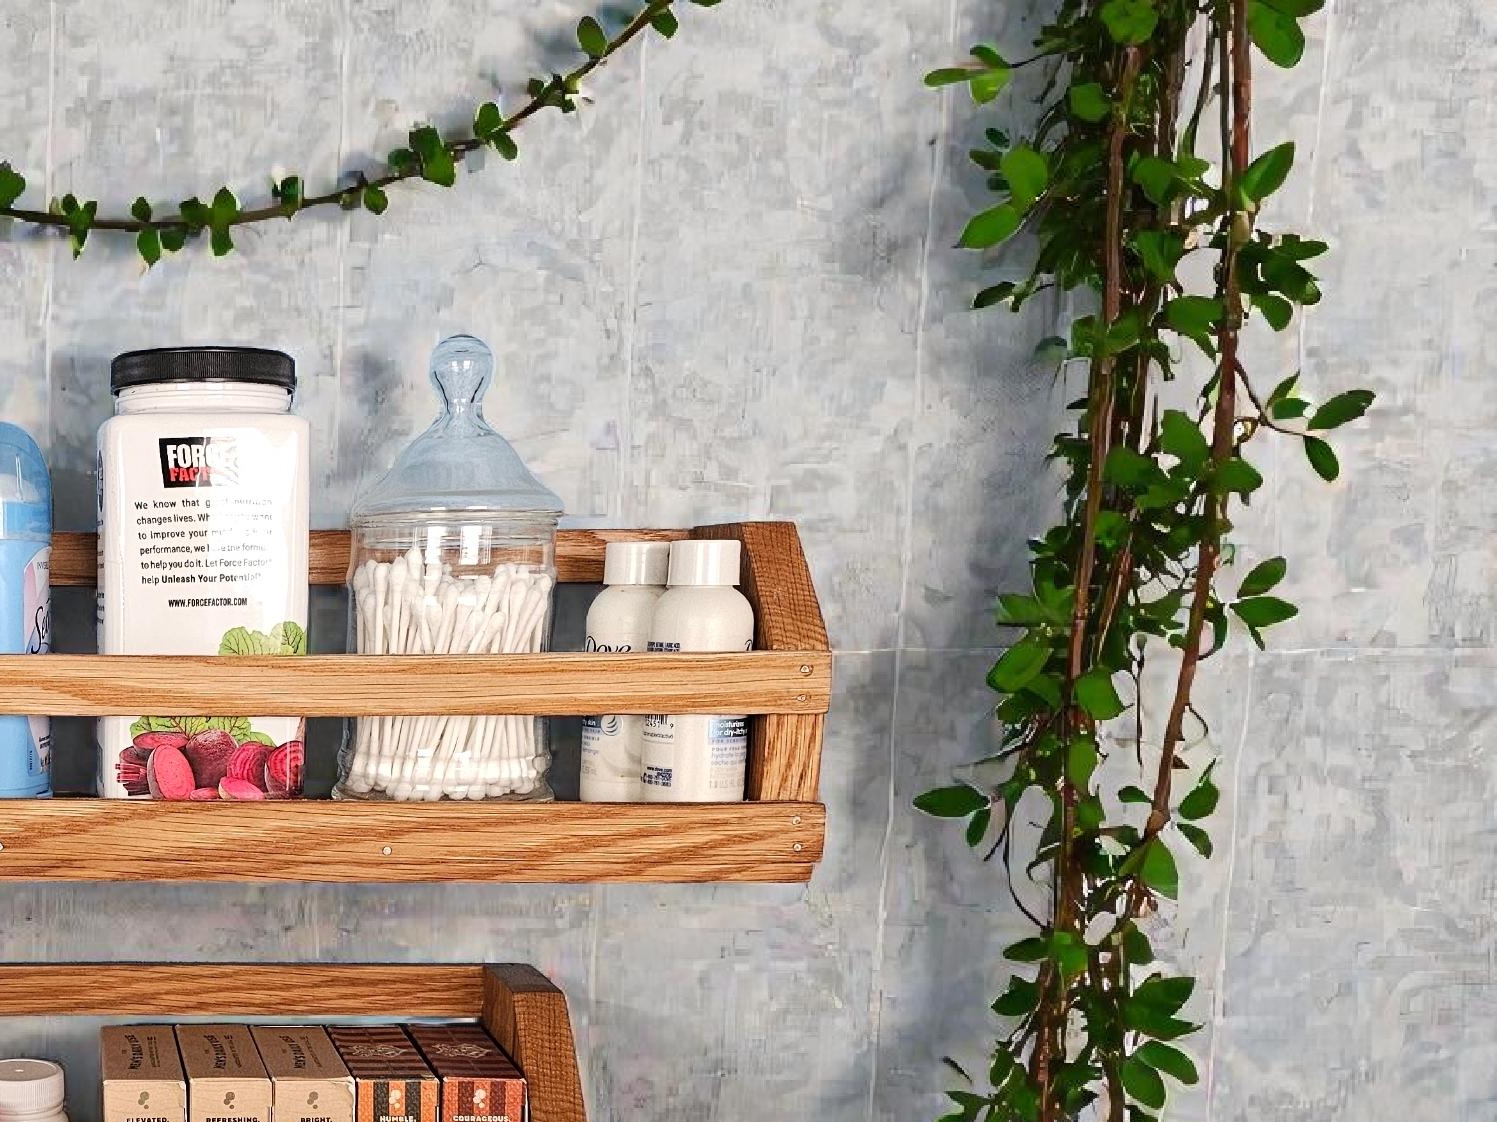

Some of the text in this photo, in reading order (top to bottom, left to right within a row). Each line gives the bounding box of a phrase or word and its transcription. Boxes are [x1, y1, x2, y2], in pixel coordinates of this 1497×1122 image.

[135, 502, 148, 510] We
[153, 500, 177, 508] know
[182, 499, 200, 507] that
[137, 514, 196, 525] changes lives.
[138, 532, 147, 540] to
[150, 530, 185, 541] improve
[188, 530, 208, 539] your
[140, 545, 192, 556] performance,
[141, 561, 149, 569] to
[150, 560, 167, 570] help
[168, 561, 183, 570] you
[184, 560, 194, 568] do
[195, 559, 204, 568] it.
[205, 559, 218, 567] Let
[219, 559, 242, 567] Force
[142, 577, 160, 585] help
[161, 575, 196, 583] Unleash
[168, 598, 248, 607] WWW.FORCEFACTOR.COM
